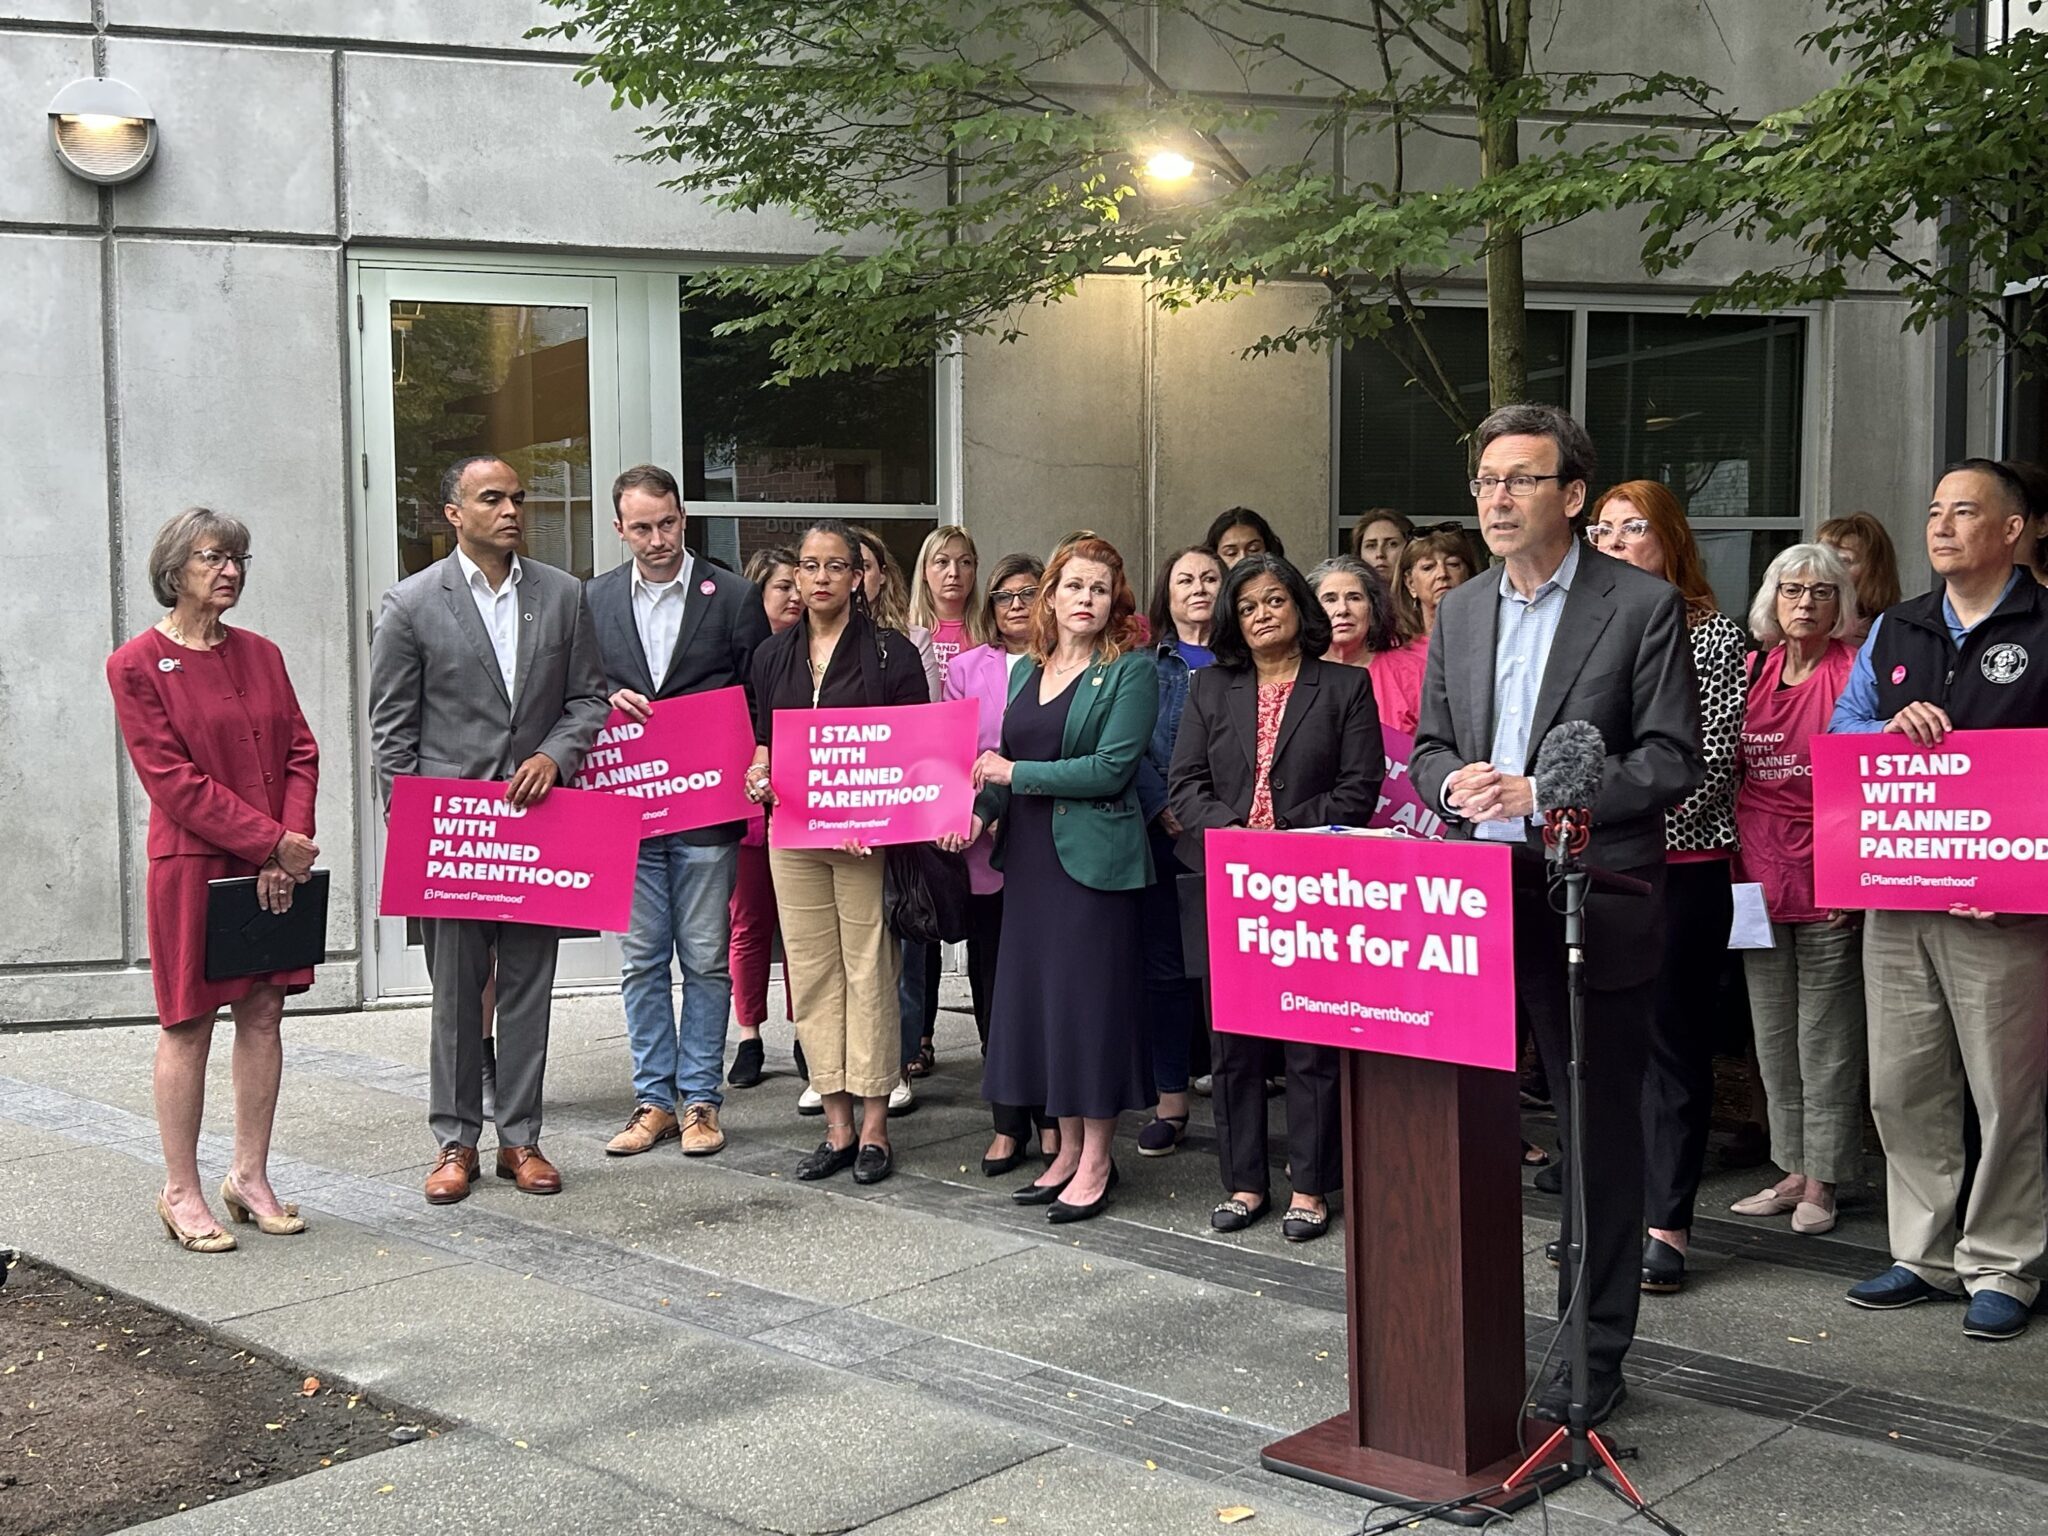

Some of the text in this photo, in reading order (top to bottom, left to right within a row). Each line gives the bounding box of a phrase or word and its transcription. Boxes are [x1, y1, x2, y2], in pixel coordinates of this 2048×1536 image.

[594, 722, 644, 747] AND
[809, 724, 891, 743] I STAND
[1740, 732, 1785, 743] STAND
[809, 747, 866, 765] WITH
[1743, 744, 1775, 755] WITH
[1859, 753, 1972, 777] I STAND
[808, 767, 904, 786] PLANNED
[808, 784, 941, 808] PARENTHOOD
[1861, 782, 1936, 804] WITH
[433, 796, 528, 818] I STAND
[433, 817, 497, 838] WITH
[817, 818, 889, 829] Planned Parenthood
[1390, 801, 1442, 838] All
[1860, 809, 1992, 832] PLANNED
[428, 839, 541, 862] PLANNED
[426, 860, 592, 889] PARENTHOOD
[1871, 874, 1975, 888] Planned Parenthood
[433, 890, 523, 904] Planned Parenthood
[1225, 862, 1488, 919] Together We
[1237, 915, 1479, 977] Fight for All
[1295, 995, 1431, 1026] Planned Parenthood
